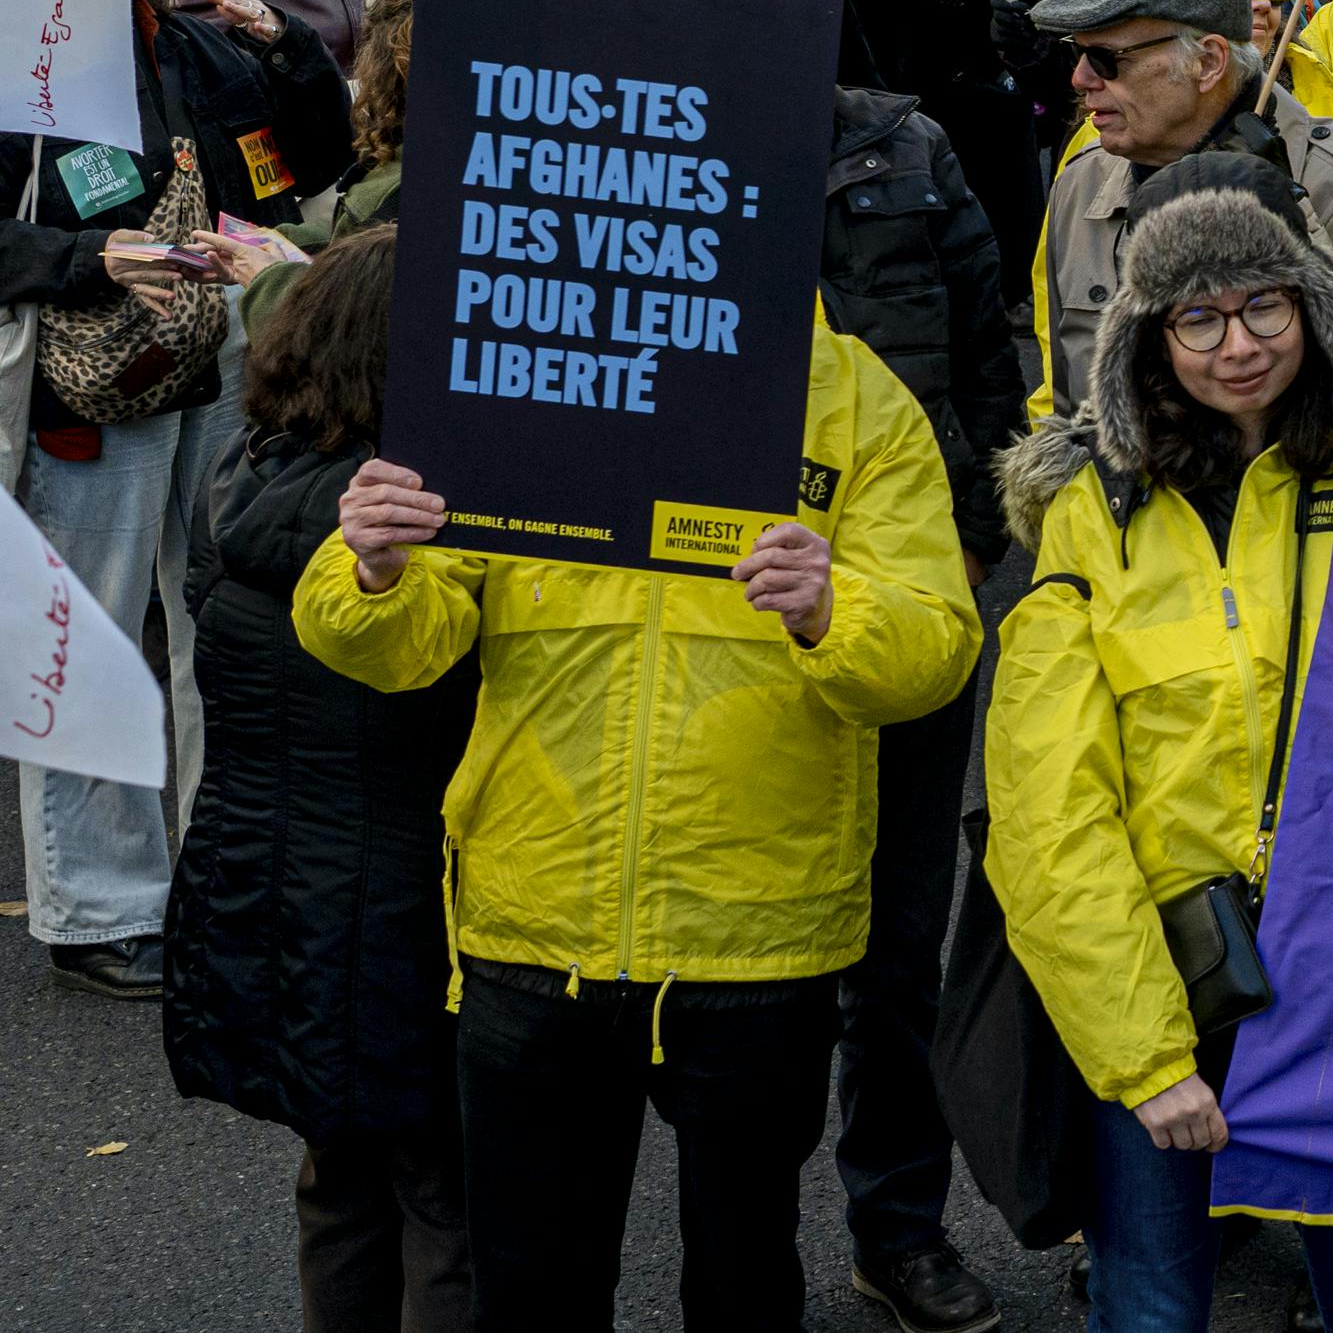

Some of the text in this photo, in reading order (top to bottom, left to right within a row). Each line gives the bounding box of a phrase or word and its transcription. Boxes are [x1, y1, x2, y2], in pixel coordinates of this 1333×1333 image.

[70, 145, 113, 172] AVORTER
[83, 159, 112, 175] EST UN
[87, 168, 117, 189] DROIT
[462, 132, 729, 217] AFGHANES
[84, 177, 130, 202] FONDAMENTAL
[460, 200, 719, 282] DES VISAS
[455, 268, 739, 355] POUR LEUR
[449, 337, 658, 414] LIBERTÉ
[508, 518, 558, 535] ON GAGNE
[667, 517, 744, 541] AMNESTY
[665, 537, 741, 556] INTERNATIONAL
